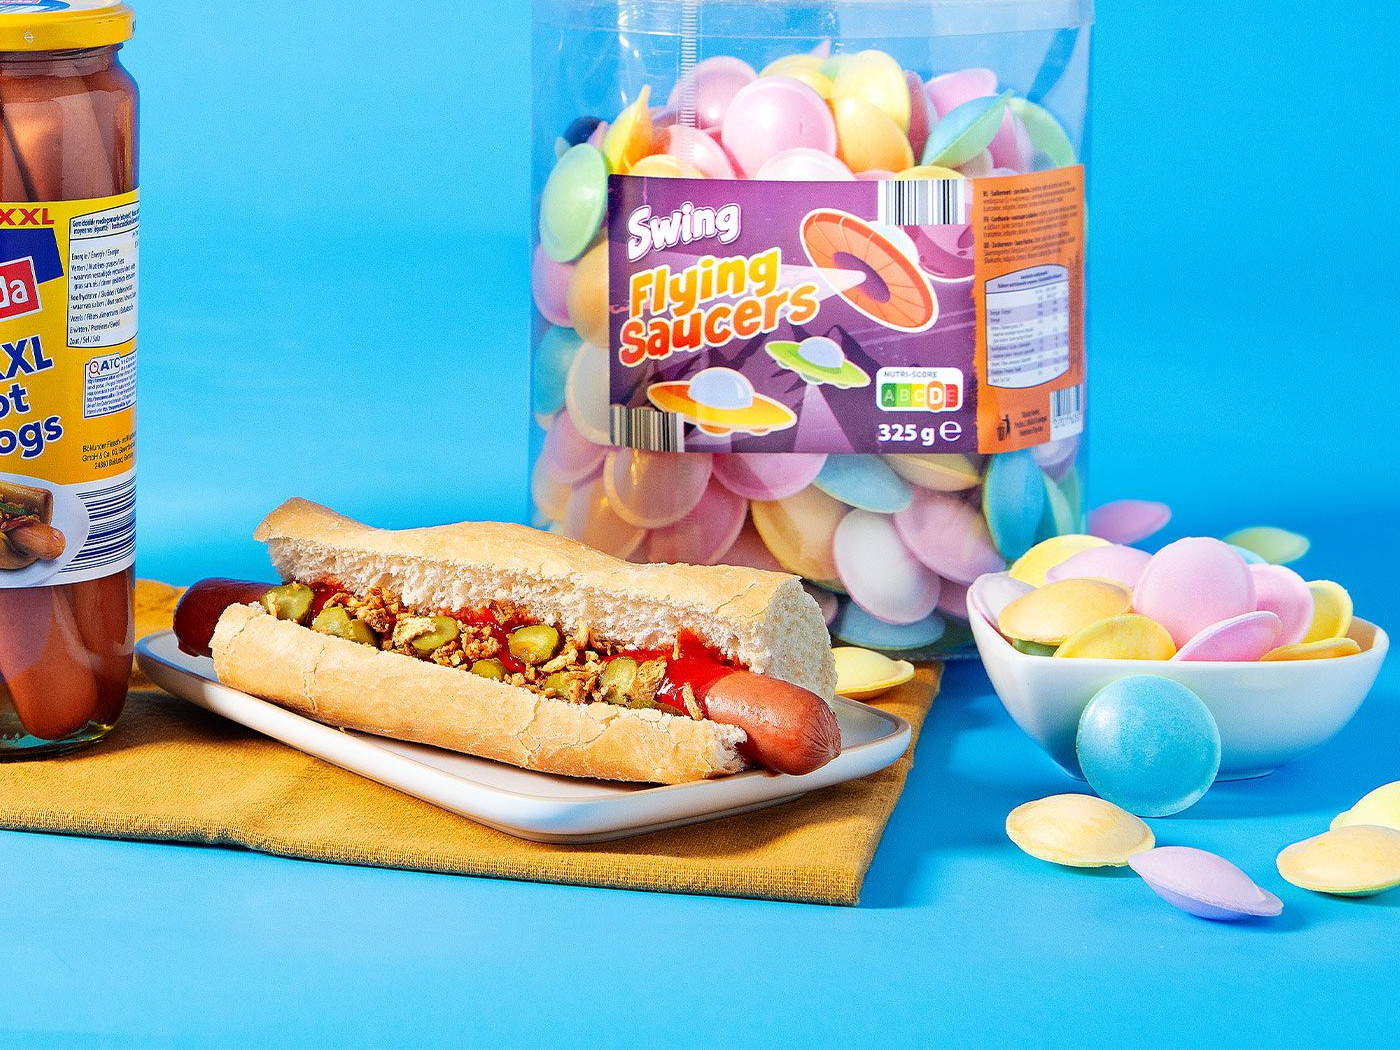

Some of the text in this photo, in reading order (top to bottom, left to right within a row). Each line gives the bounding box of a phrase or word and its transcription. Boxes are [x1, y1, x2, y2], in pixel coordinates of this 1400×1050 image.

[627, 201, 741, 262] Swing
[630, 247, 781, 319] Flying
[620, 283, 820, 368] Saucers
[100, 357, 120, 371] ATC
[884, 388, 955, 404] A B C D E
[878, 424, 917, 441] 325
[921, 428, 935, 446] g
